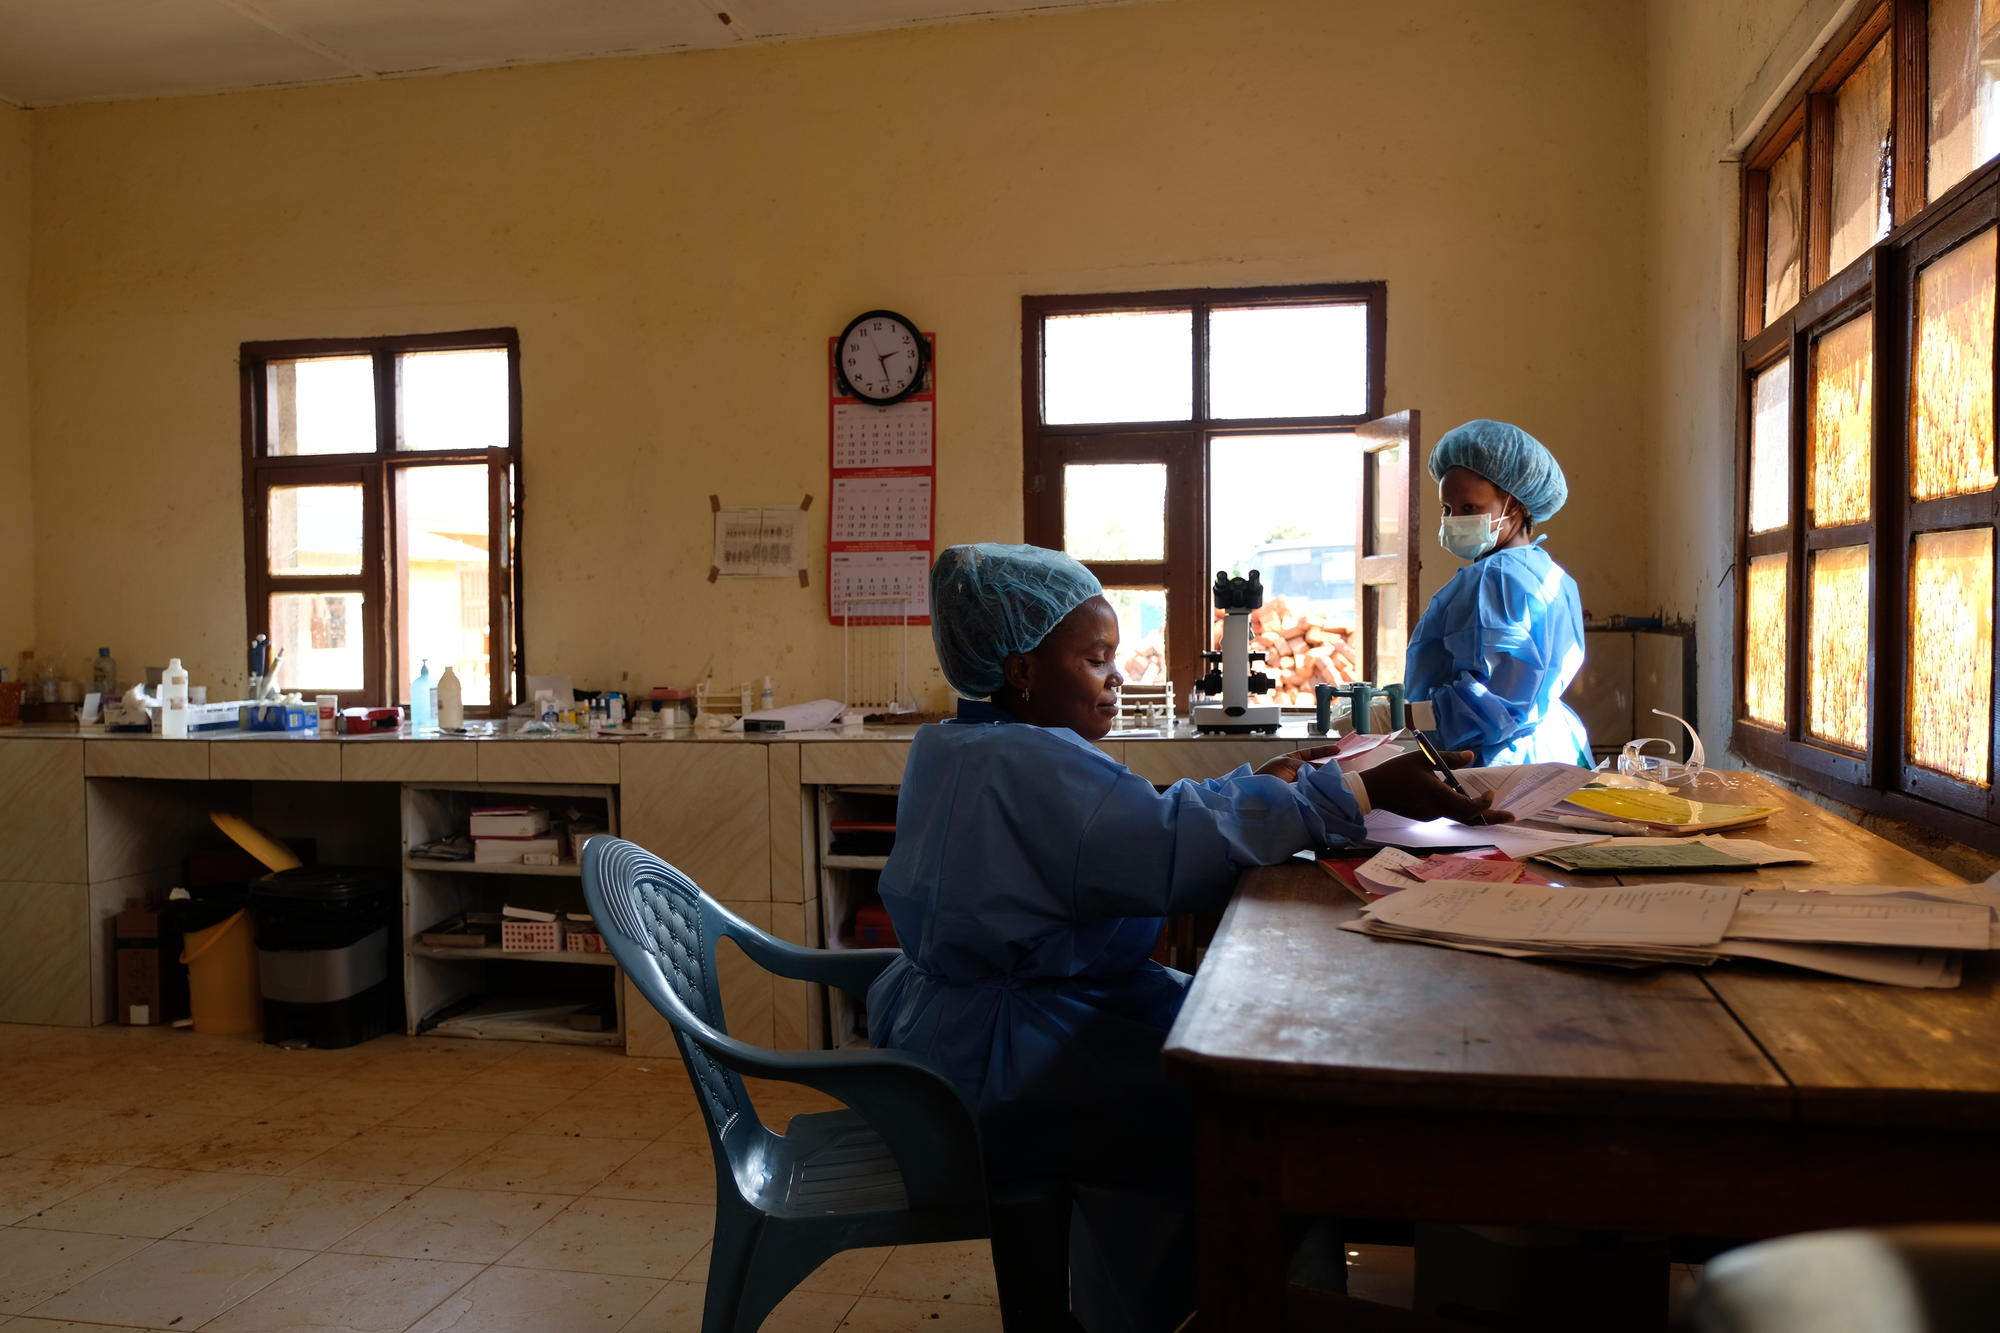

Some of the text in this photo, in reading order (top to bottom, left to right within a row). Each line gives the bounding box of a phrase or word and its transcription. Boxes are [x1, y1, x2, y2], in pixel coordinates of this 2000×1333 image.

[873, 323, 882, 331] 12
[903, 336, 910, 344] 2
[850, 344, 859, 352] 10
[907, 349, 915, 358] 3
[848, 359, 856, 367] 9
[907, 365, 912, 374] 4
[855, 373, 862, 381] 8
[866, 383, 872, 391] 7
[897, 380, 904, 389] 5
[881, 385, 889, 394] 6
